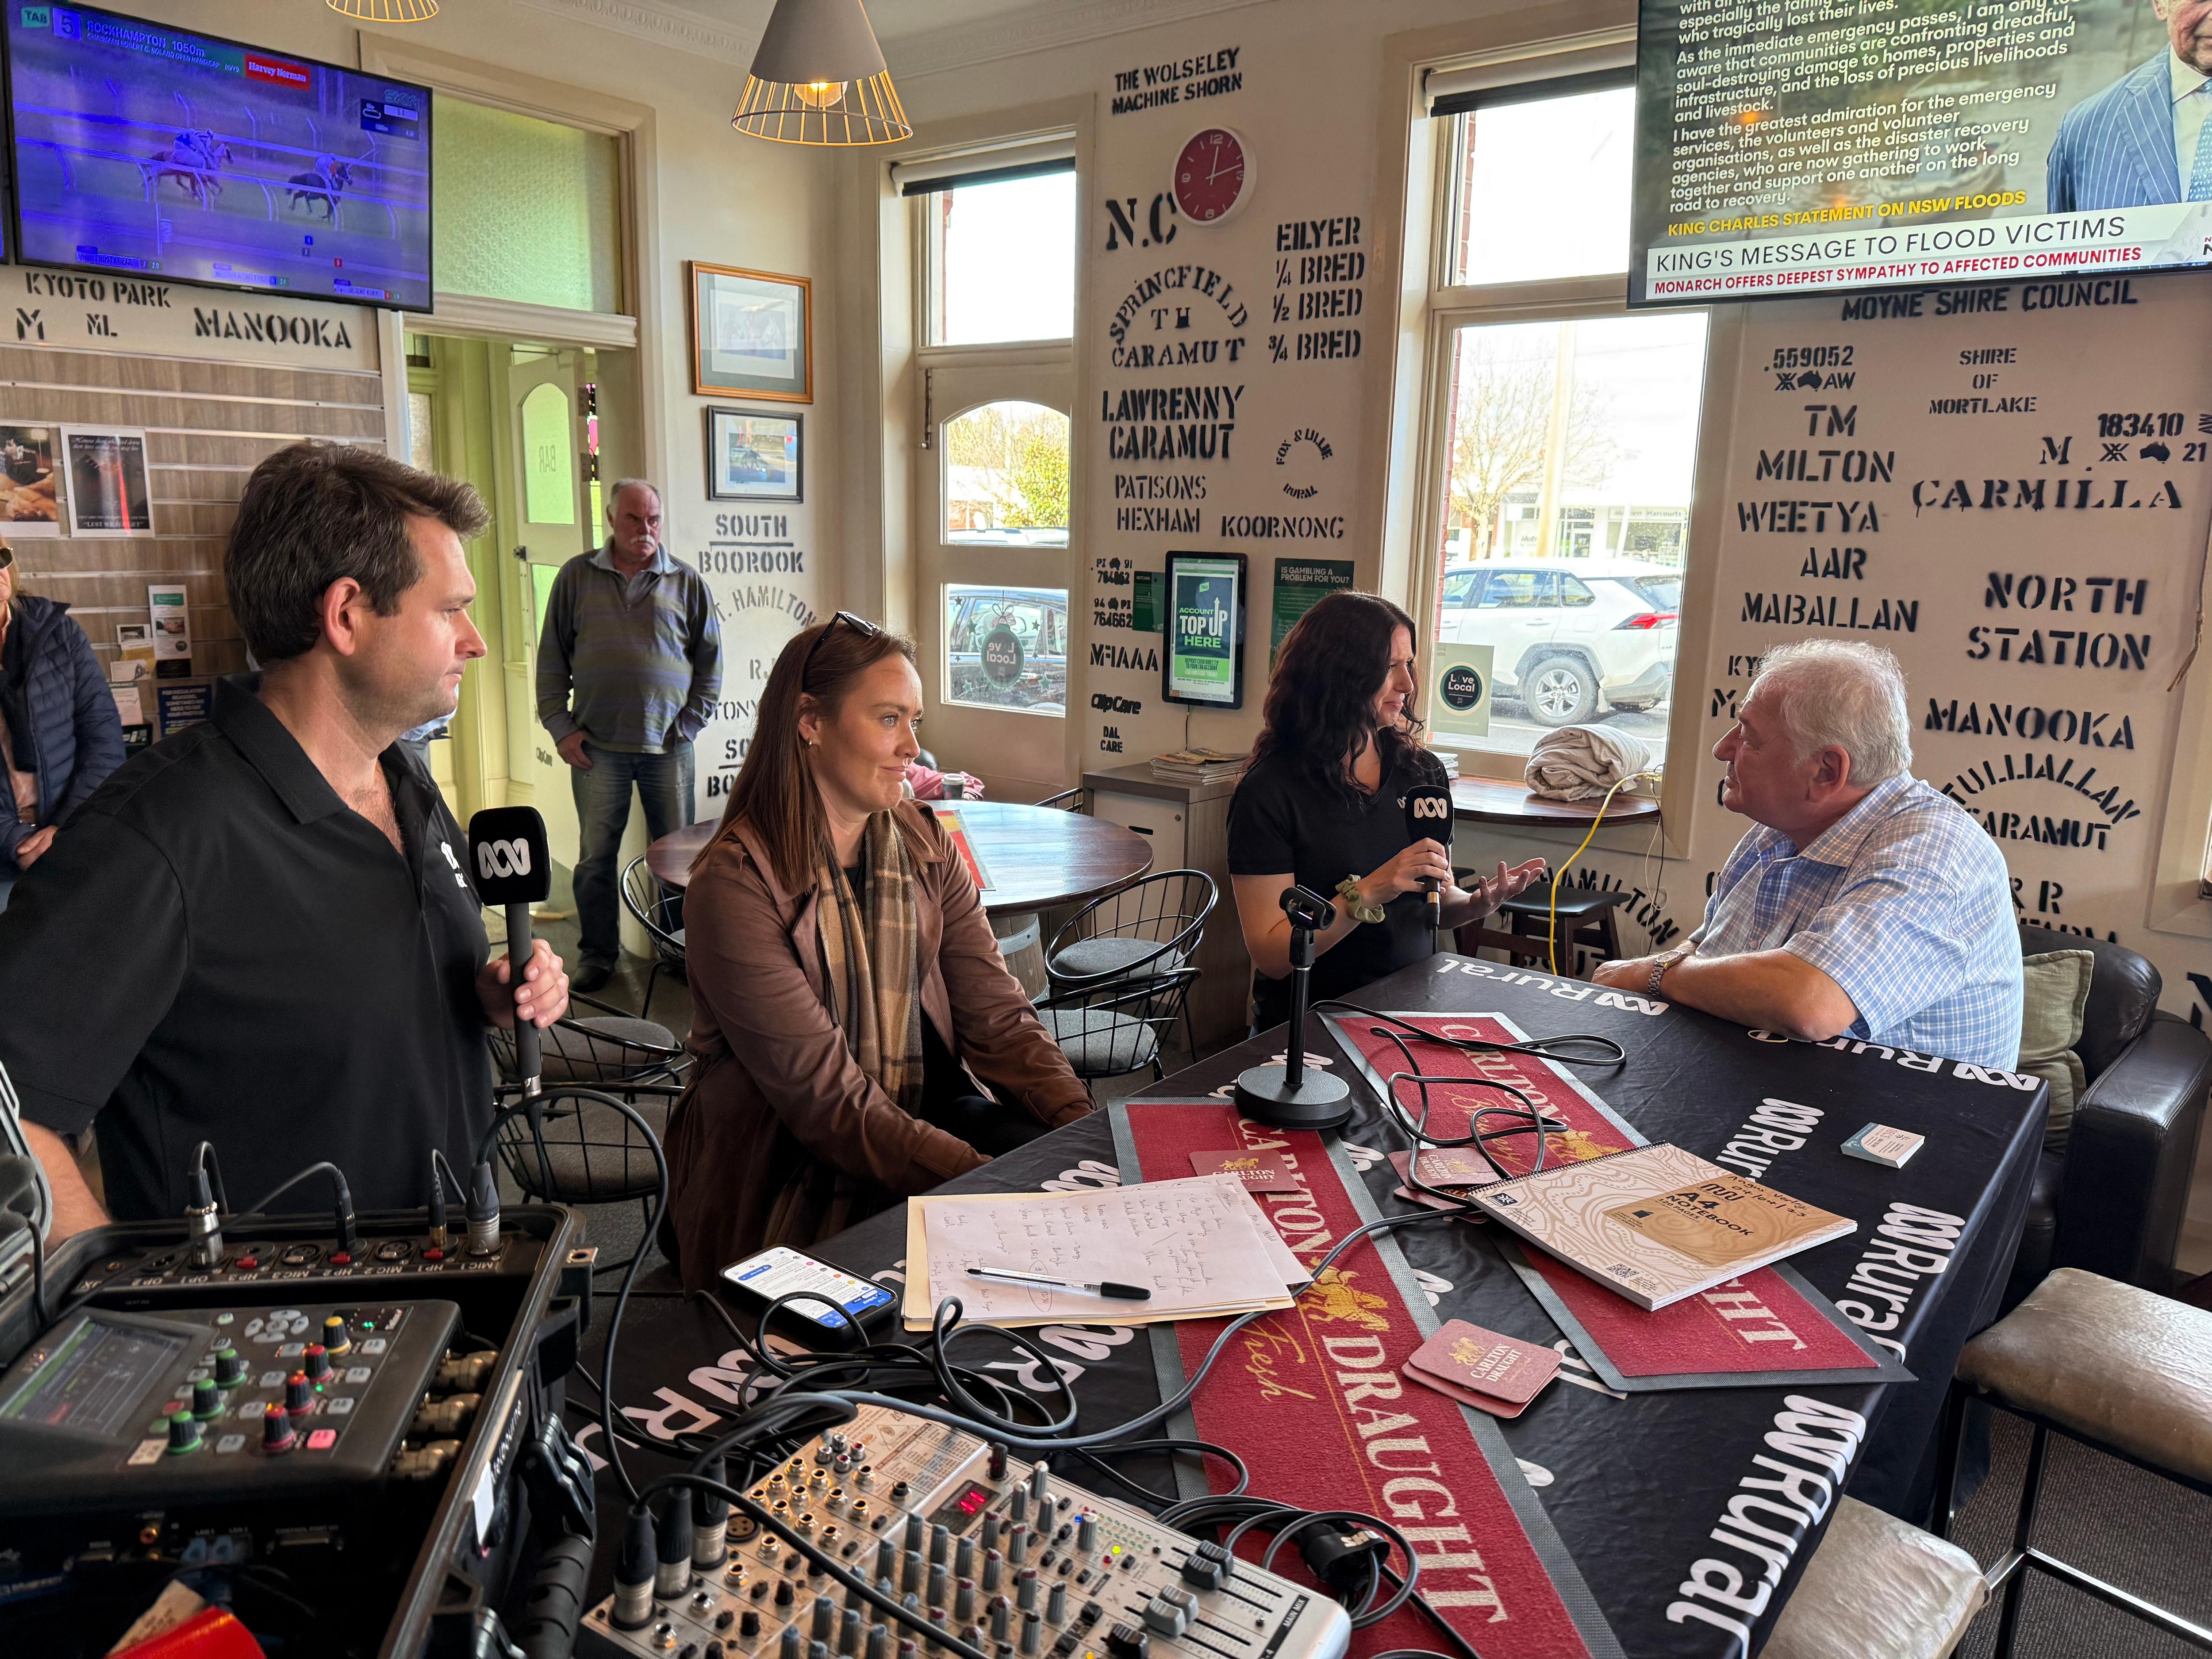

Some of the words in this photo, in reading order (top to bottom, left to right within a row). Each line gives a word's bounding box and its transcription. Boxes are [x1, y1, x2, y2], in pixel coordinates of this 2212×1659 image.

[24, 10, 47, 24] TAB
[61, 15, 74, 34] 5
[1677, 50, 1695, 64] As
[1698, 46, 1721, 60] the
[1725, 32, 1803, 56] immediate
[1807, 20, 1895, 46] emergency
[1900, 9, 1962, 33] passes,
[1968, 5, 1972, 19] I
[1977, 3, 2004, 17] am
[1679, 27, 1709, 44] who
[1712, 14, 1783, 41] tragically
[1788, 9, 1815, 26] lost
[1818, 2, 1855, 21] their
[1859, 0, 1898, 15] lives.
[249, 61, 274, 77] Harvey
[1115, 69, 1139, 92] THE
[1144, 47, 1240, 84] WOLSELEY
[1675, 81, 1777, 109] infrastructure,
[1782, 76, 1811, 92] and
[1814, 73, 1839, 88] the
[1844, 67, 1874, 84] loss
[1878, 64, 1895, 79] of
[1899, 54, 1969, 80] precious
[1974, 39, 2068, 66] livelihoods
[1676, 64, 1790, 96] soul-destroying
[1794, 54, 1859, 79] damage
[1862, 53, 1878, 65] to
[1883, 41, 1942, 67] homes,
[1946, 28, 2035, 58] properties
[2039, 21, 2075, 40] and
[1111, 86, 1179, 115] MACHINE
[1184, 73, 1242, 100] SHORN
[1210, 134, 1223, 145] 12
[1667, 222, 1706, 236] KING
[1709, 215, 1779, 232] CHARLES
[1783, 205, 1874, 225] STATEMENT
[1878, 203, 1904, 216] ON
[1909, 198, 1951, 214] NSW
[1955, 191, 2026, 210] FLOODS
[1657, 250, 1733, 272] KING'S
[1742, 239, 1856, 265] MESSAGE
[1864, 236, 1897, 256] TO
[1907, 227, 1995, 253] FLOOD
[2005, 217, 2125, 245] VICTIMS
[1300, 252, 1365, 285] BRED
[1655, 278, 1721, 294] MONARCH
[1726, 274, 1773, 289] OFFERS
[1777, 270, 1832, 285] DEEPEST
[1836, 264, 1916, 281] SYMPATHY
[1921, 262, 1939, 275] TO
[1944, 256, 2019, 273] AFFECTED
[2024, 247, 2141, 268] COMMUNITIES
[27, 272, 104, 303] KYOTO
[114, 281, 172, 308] PARK
[1298, 288, 1363, 320] BRED
[1841, 292, 1924, 322] MOYNE
[1935, 287, 2010, 316] SHIRE
[2022, 279, 2138, 311] COUNCIL
[16, 307, 44, 341] M
[194, 307, 352, 349] MANOOKA
[1112, 337, 1245, 368] CARAMUT
[1297, 330, 1361, 361] BRED
[1959, 347, 2017, 365] SHIRE
[1972, 373, 1999, 389] OF
[1102, 384, 1245, 422] LAWRENNY
[1929, 396, 2037, 415] MORTLAKE
[1804, 404, 1858, 437] TM
[2097, 412, 2185, 438] 183410
[1109, 423, 1235, 460] CARAMUT
[2182, 442, 2207, 462] 21
[1756, 449, 1895, 483] MILTON
[1115, 474, 1206, 499] PATISONS
[1283, 483, 1318, 499] RURAL
[1912, 479, 2181, 509] CARMILLA
[715, 514, 787, 538] SOUTH
[1117, 507, 1200, 533] HEXHAM
[1221, 515, 1344, 539] KOORNONG
[1737, 501, 1879, 533] WEETYA
[698, 551, 804, 574] BOOROOK
[1281, 573, 1313, 582] PROBLEM
[1289, 567, 1326, 575] GAMBLING
[1800, 547, 1867, 580] AAR
[731, 585, 817, 626] HAMILTON
[1985, 572, 2148, 615] NORTH
[1179, 615, 1206, 635] TOP
[1209, 602, 1228, 637] UP
[1741, 592, 1919, 633] MABALLAN
[1184, 635, 1221, 648] HERE
[1966, 626, 2151, 670] STATION
[1728, 655, 1762, 678] KY
[1448, 681, 1475, 692] Local
[1102, 726, 1120, 739] DAL
[1925, 698, 2134, 750] MANOOKA
[1100, 740, 1123, 753] CARE
[1939, 753, 2141, 825] TULLIALLAN
[1967, 808, 2111, 850] ARAMUT
[1436, 958, 1594, 1002] Rural
[1418, 1156, 1441, 1179] DRAUGHT
[1428, 1154, 1455, 1179] CARLTON
[1716, 1124, 1807, 1182] Rur
[1658, 1198, 1674, 1207] 120
[1673, 1206, 1701, 1220] PAGES
[1665, 1195, 1755, 1236] NOTEBOOK
[1675, 1192, 1721, 1210] A4
[1470, 1343, 1512, 1379] CARLTON
[1485, 1348, 1523, 1383] DRAUGHT
[1321, 1334, 1509, 1624] DRAUGHT
[1666, 1454, 1832, 1659] Rural
[1283, 1610, 1298, 1628] MAIN
[1292, 1598, 1306, 1612] MIX
